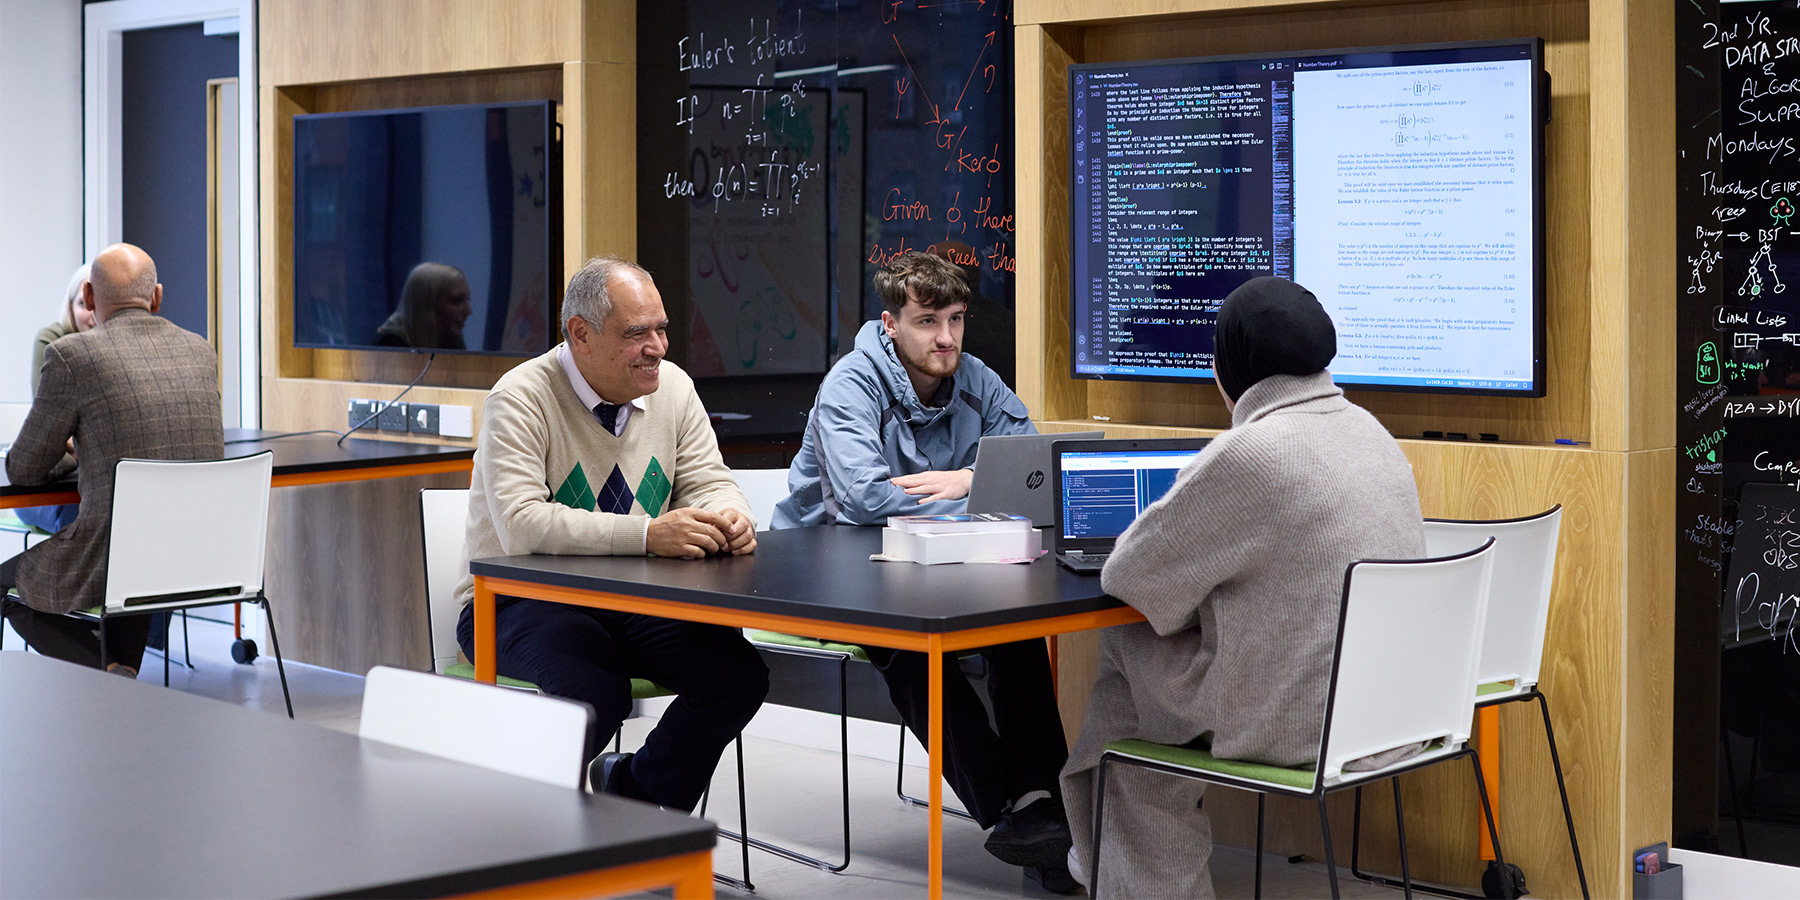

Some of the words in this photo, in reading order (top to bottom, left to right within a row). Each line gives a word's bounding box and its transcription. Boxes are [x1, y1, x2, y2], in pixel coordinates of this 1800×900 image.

[678, 32, 734, 71] Euler's
[747, 8, 806, 65] totient
[1703, 22, 1738, 50] 2nd
[1726, 41, 1770, 69] DATA
[676, 95, 698, 135] If
[664, 172, 695, 199] then
[1700, 171, 1758, 200] Thursdays
[882, 188, 932, 222] Given
[974, 196, 1015, 232] there
[1758, 226, 1784, 242] BST
[946, 246, 979, 268] such
[1756, 310, 1787, 328] Lists
[1724, 402, 1756, 418] AZA
[1026, 470, 1044, 490] hp
